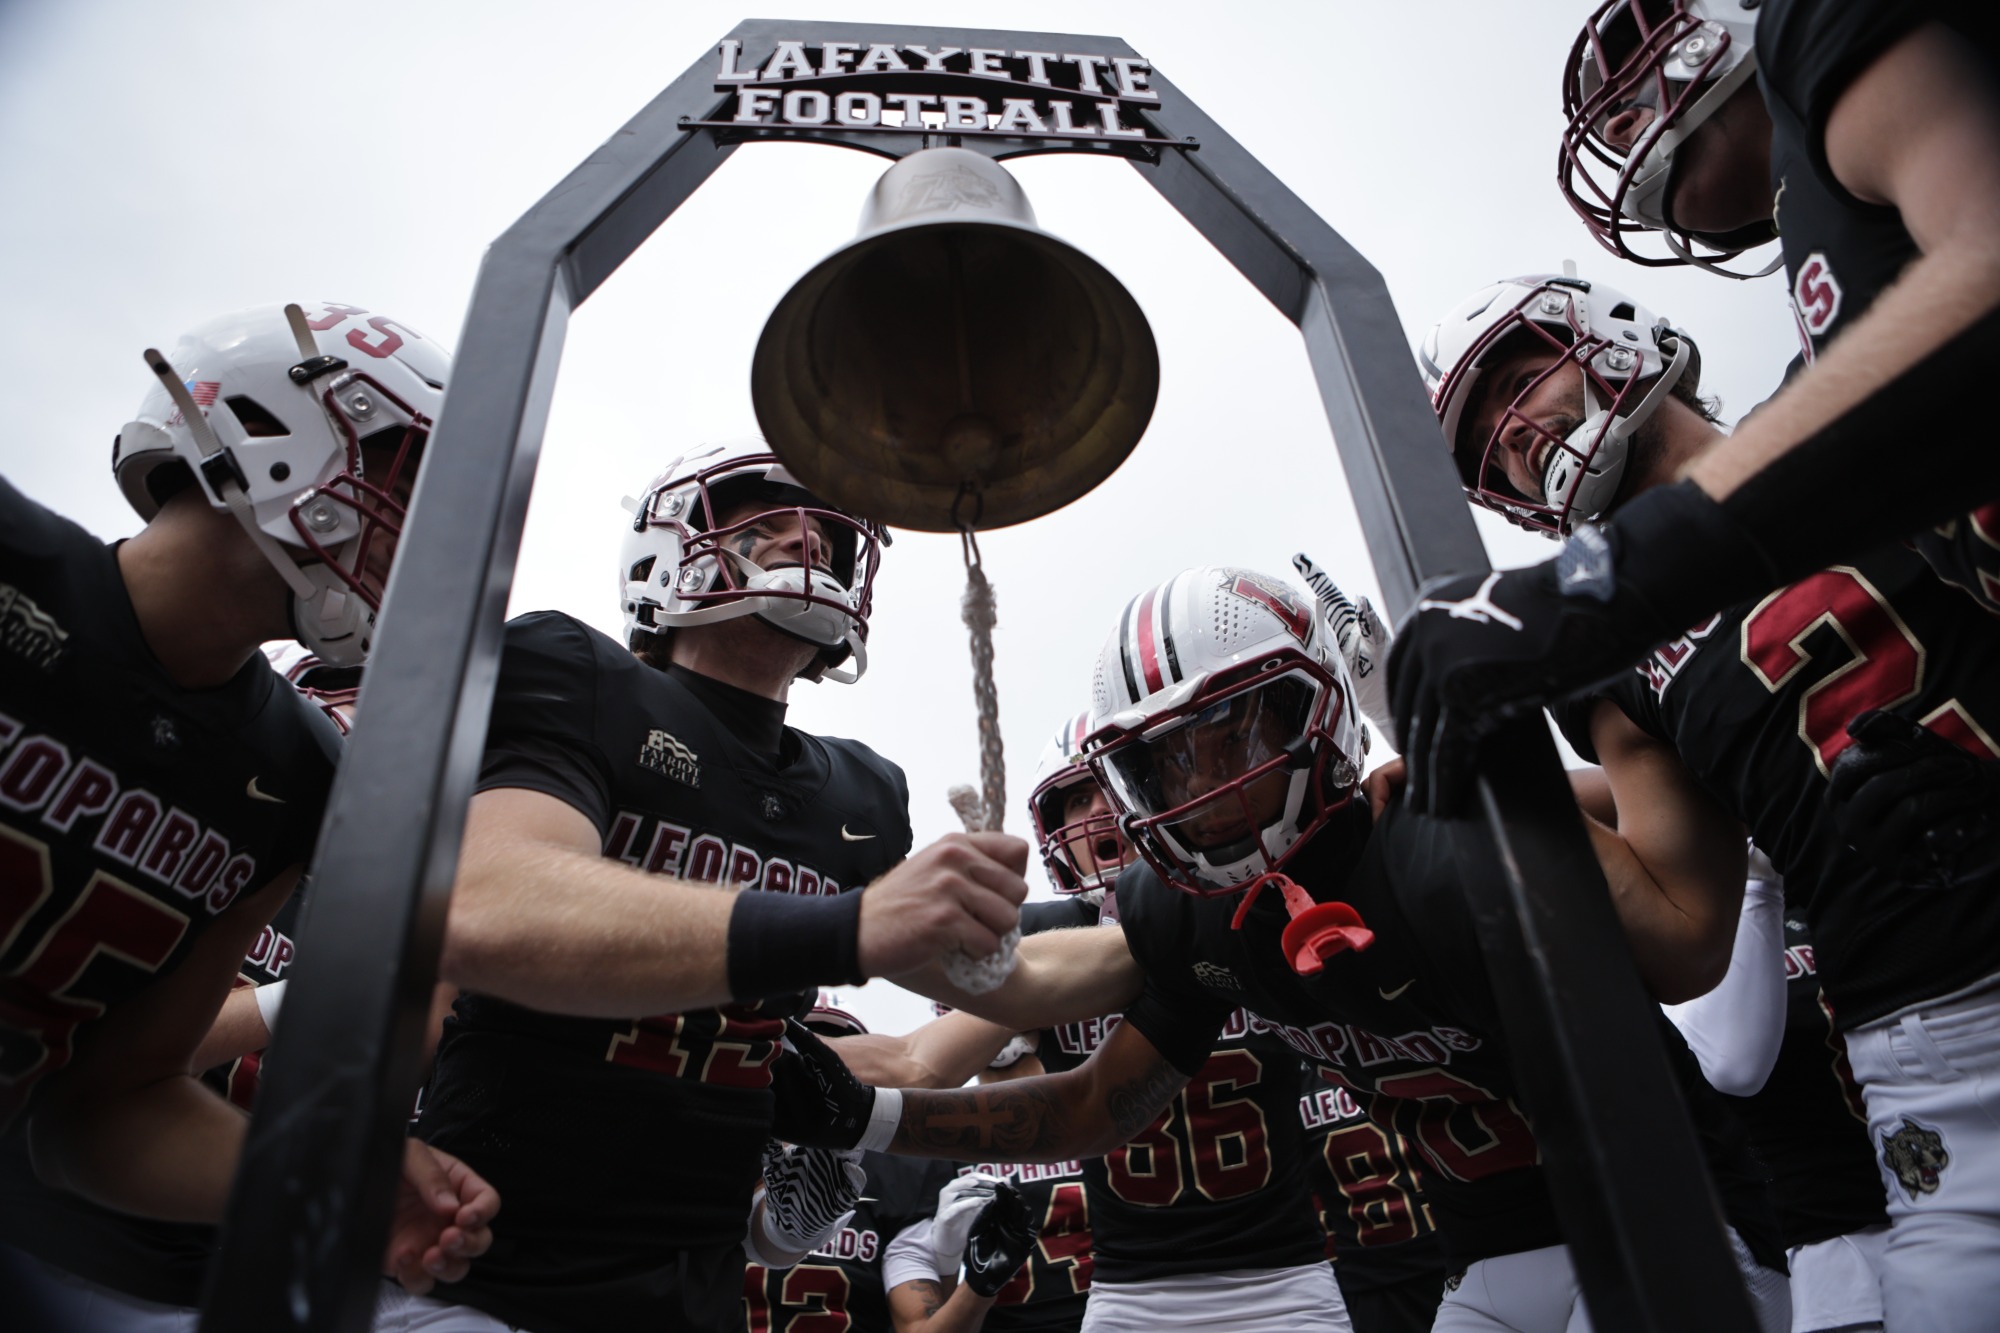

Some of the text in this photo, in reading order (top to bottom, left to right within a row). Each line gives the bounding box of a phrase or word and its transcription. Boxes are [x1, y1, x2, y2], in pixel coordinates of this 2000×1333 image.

[717, 39, 1159, 100] LAFAYETTE
[733, 88, 1145, 138] FOOTBALL
[640, 754, 700, 788] LEAGUE
[641, 744, 700, 777] PATRIOT
[0, 711, 256, 916] OPARDS
